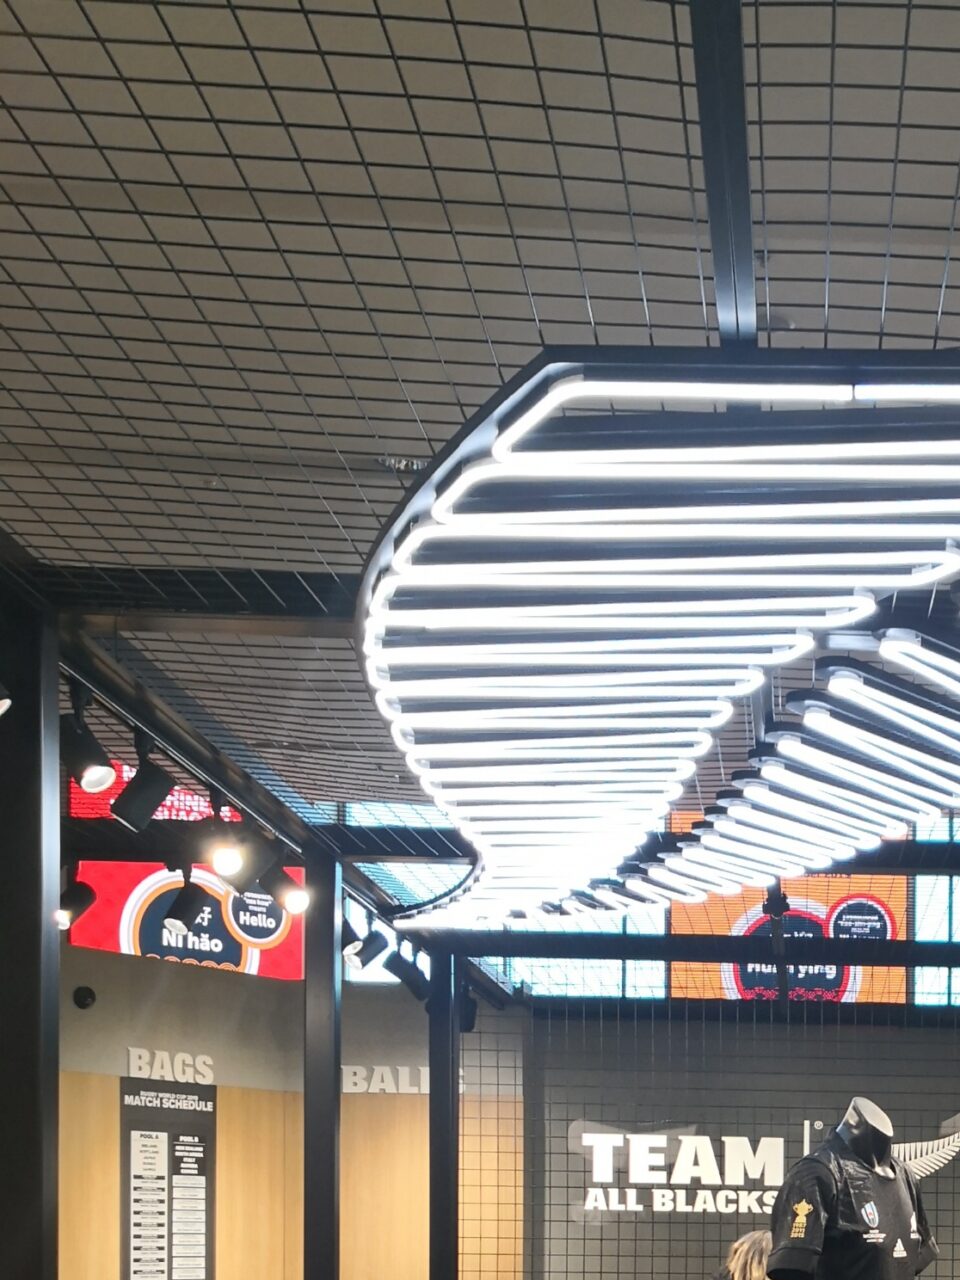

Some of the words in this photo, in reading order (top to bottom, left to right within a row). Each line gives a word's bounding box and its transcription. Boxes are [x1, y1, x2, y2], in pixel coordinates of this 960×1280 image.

[240, 911, 276, 929] Hello
[127, 1046, 214, 1085] BAGS
[340, 1065, 465, 1095] BALL
[124, 1095, 160, 1108] MATCH
[162, 1098, 213, 1112] SCHEDULE
[582, 1133, 784, 1186] TEAM
[584, 1188, 643, 1211] ALL
[652, 1189, 778, 1214] BLACKS
